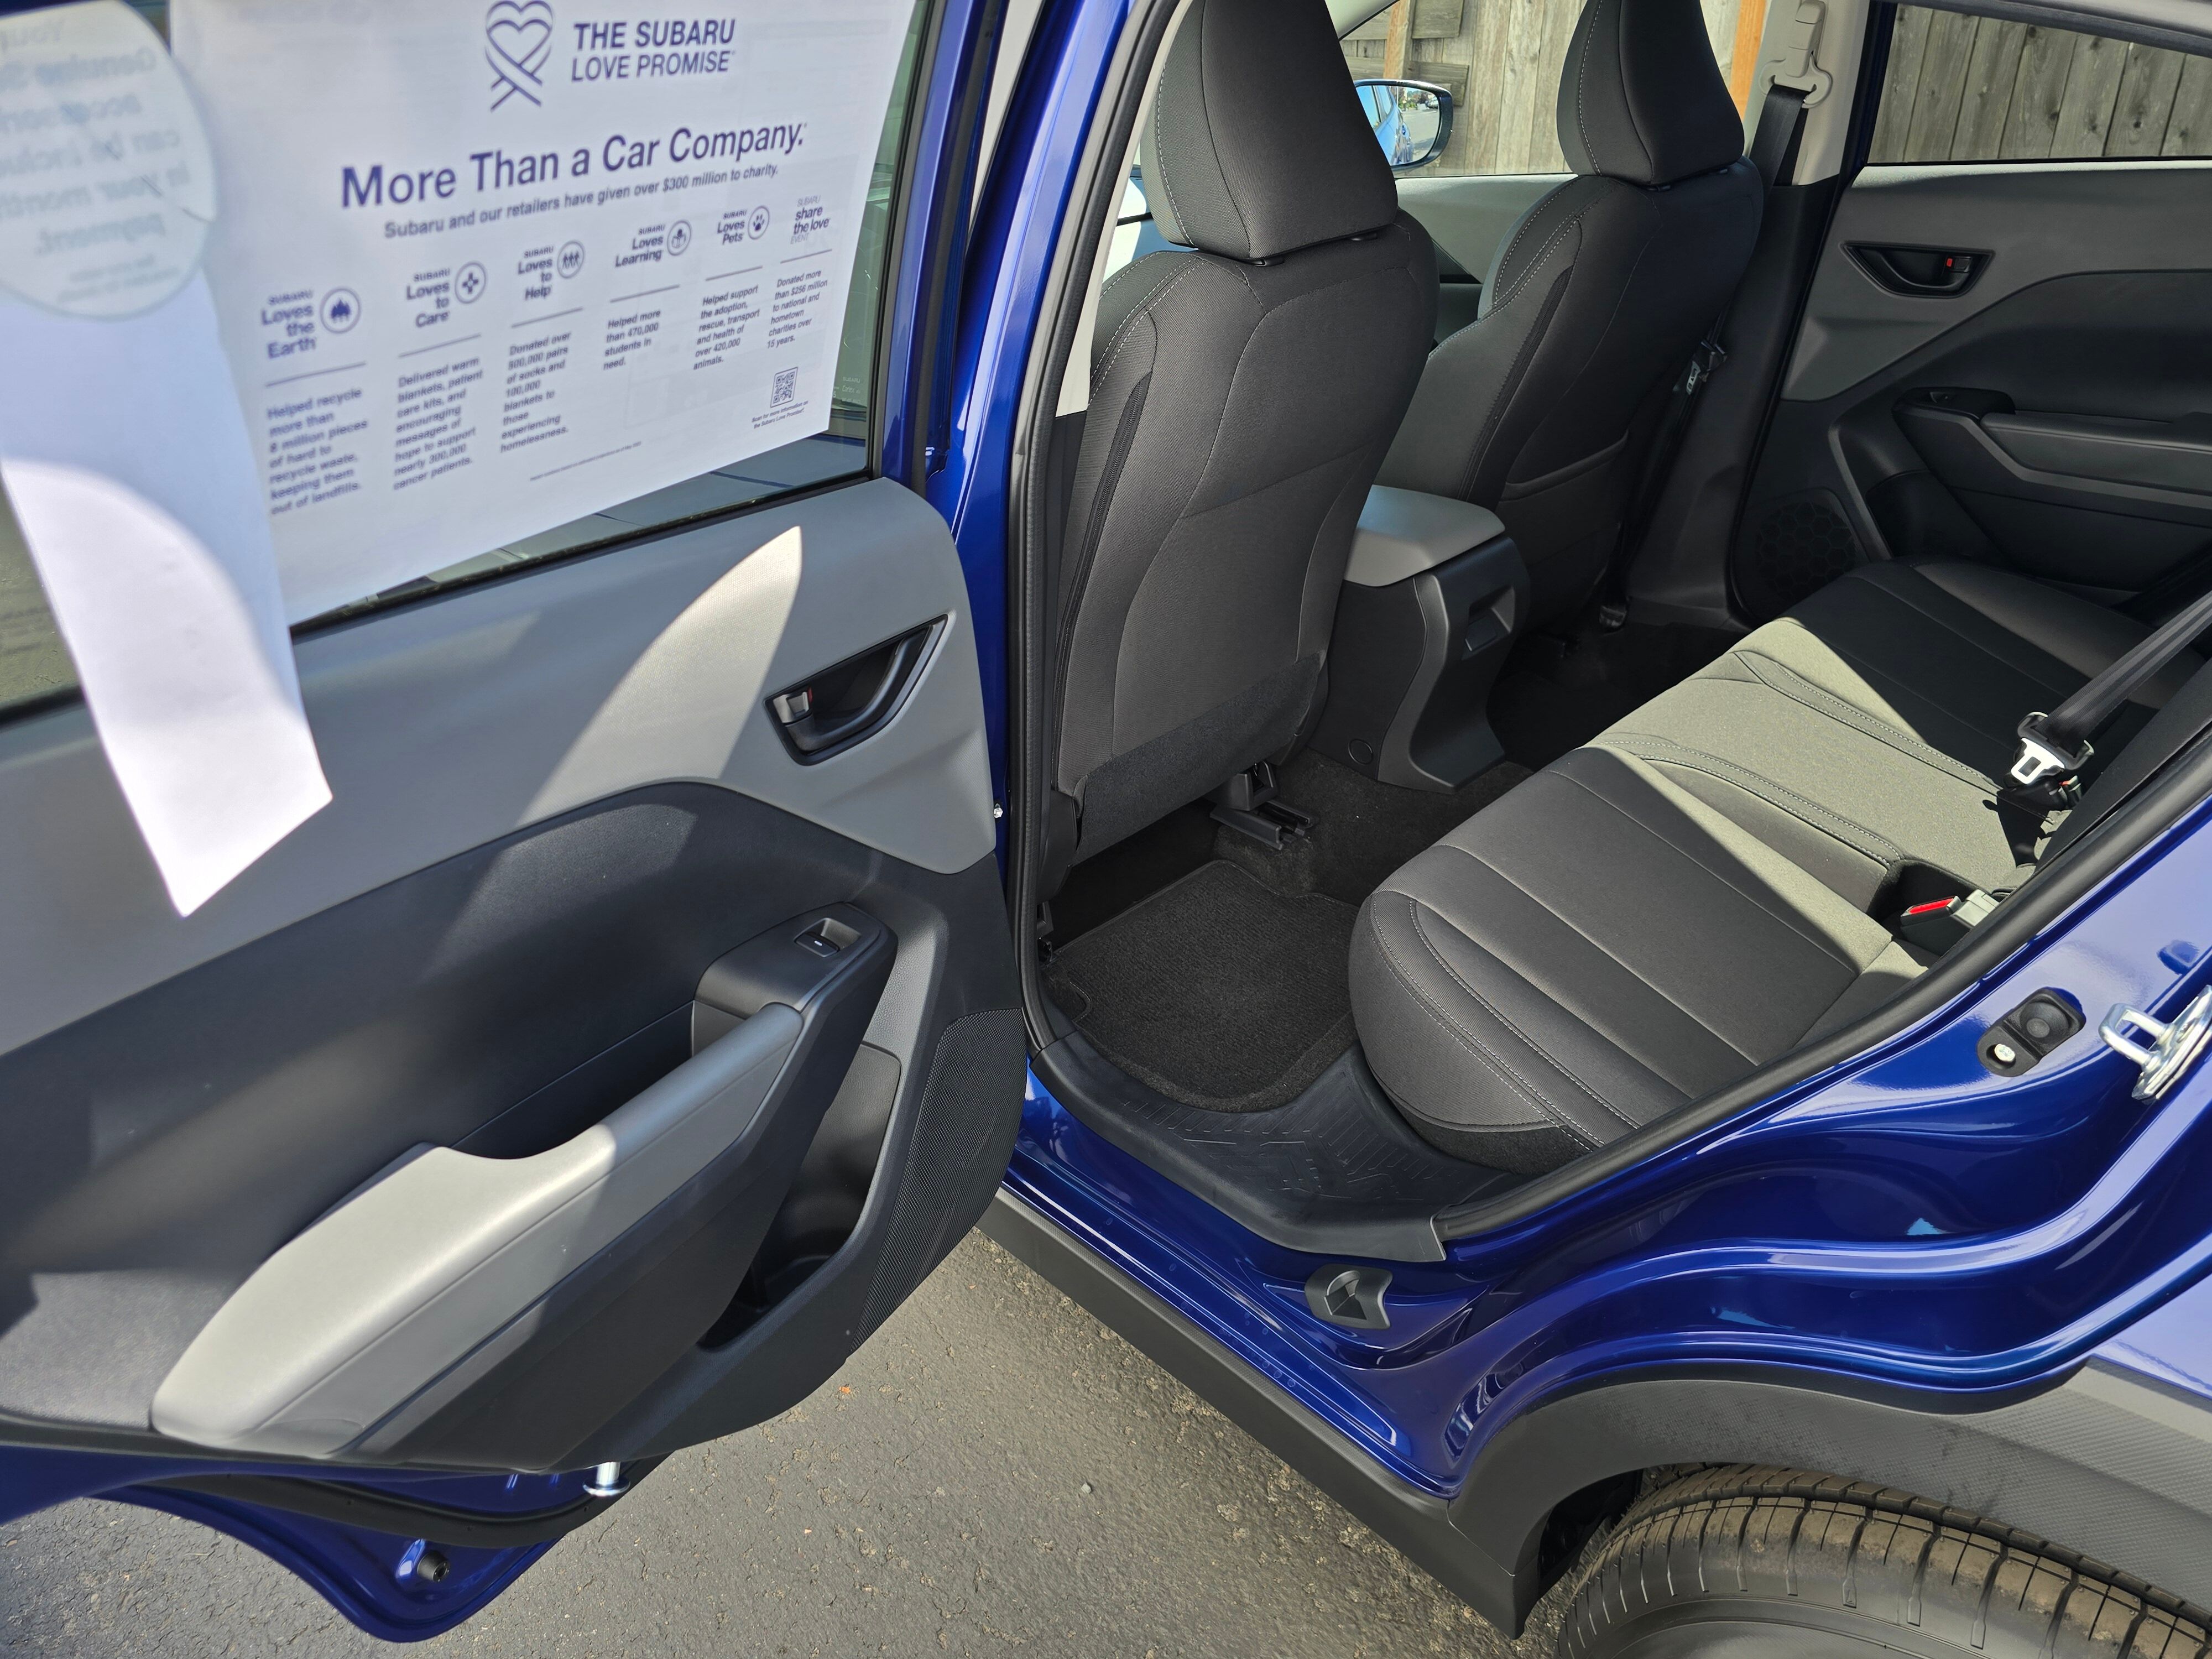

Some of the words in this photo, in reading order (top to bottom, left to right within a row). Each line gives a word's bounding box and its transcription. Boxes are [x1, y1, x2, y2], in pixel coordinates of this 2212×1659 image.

[573, 21, 628, 50] THE
[634, 18, 735, 48] SUBARU
[571, 55, 631, 82] LOVE
[636, 50, 732, 78] PROMISE
[341, 164, 457, 208] More
[469, 149, 560, 193] Than
[571, 147, 591, 177] a
[602, 134, 660, 171] Car
[669, 122, 804, 161] Company.
[384, 218, 444, 238] Subaru
[449, 211, 475, 229] and
[480, 208, 503, 223] our
[507, 196, 560, 218] retailers
[564, 188, 593, 208] have
[597, 185, 630, 205] given
[634, 182, 660, 195] over
[662, 175, 688, 192] $300
[692, 172, 727, 187] million
[731, 169, 740, 181] to
[743, 164, 779, 180] charity.
[797, 195, 821, 207] SUBARU
[723, 210, 747, 220] SUBARU
[795, 206, 823, 221] share
[638, 225, 665, 235] SUBARU
[717, 221, 745, 234] Loves
[794, 222, 809, 234] the
[810, 218, 829, 231] love
[632, 236, 664, 250] Loves
[722, 233, 743, 245] Pets
[790, 234, 809, 244] EVENT
[524, 246, 554, 258] SUBARU
[615, 249, 662, 268] Learning
[414, 268, 450, 282] SUBARU
[518, 259, 553, 275] Loves
[540, 272, 552, 283] to
[776, 273, 805, 288] Donated
[805, 270, 821, 280] more
[406, 282, 450, 300] Loves
[524, 285, 552, 300] Help
[702, 291, 729, 306] Helped
[730, 284, 759, 299] support
[775, 290, 789, 300] than
[791, 284, 805, 296] $256
[807, 279, 828, 291] million
[436, 297, 450, 309] to
[701, 311, 712, 320] the
[714, 302, 748, 316] adoption,
[773, 304, 779, 312] to
[781, 295, 807, 310] national
[808, 292, 820, 302] and
[261, 305, 314, 326] Loves
[415, 311, 449, 328] Care
[608, 314, 638, 330] Helped
[640, 310, 661, 322] more
[698, 320, 726, 332] rescue,
[727, 309, 760, 325] transport
[770, 310, 804, 325] hometown
[286, 322, 315, 337] the
[606, 332, 625, 343] than
[628, 322, 659, 337] 470,000
[697, 333, 711, 345] and
[713, 328, 735, 341] health
[737, 324, 745, 334] of
[769, 324, 796, 337] charities
[798, 318, 812, 328] over
[267, 338, 316, 359] Earth
[509, 337, 550, 356] Donated
[551, 332, 571, 344] over
[605, 341, 641, 356] students
[695, 347, 712, 358] over
[713, 338, 740, 352] 420,000
[767, 339, 775, 349] 15
[776, 335, 795, 348] years.
[546, 347, 568, 361] pairs
[693, 356, 724, 370] animals.
[398, 364, 448, 388] Delivered
[452, 357, 479, 372] warm
[507, 373, 517, 385] of
[519, 367, 546, 381] socks
[548, 359, 566, 372] and
[603, 357, 626, 371] need.
[398, 383, 445, 404] blankets,
[448, 369, 483, 389] patient
[267, 398, 313, 419] Helped
[317, 389, 362, 406] recycle
[397, 404, 420, 419] care
[424, 397, 444, 410] kits,
[447, 389, 466, 403] and
[504, 394, 543, 413] blankets
[546, 389, 555, 400] to
[270, 421, 302, 436] more
[306, 413, 334, 427] than
[397, 406, 461, 433] encouraging
[502, 415, 561, 440] experiencing
[503, 411, 529, 426] those
[328, 420, 368, 439] pieces
[395, 424, 448, 447] messages
[451, 417, 462, 430] of
[395, 447, 421, 462] hope
[424, 442, 434, 452] to
[437, 426, 476, 447] support
[500, 426, 568, 453] homelessness.
[269, 456, 283, 468] of
[287, 447, 316, 463] hard
[320, 446, 331, 455] to
[269, 465, 316, 483] recycle
[394, 459, 425, 476] nearly
[394, 472, 428, 491] cancer
[431, 456, 472, 479] patients.
[270, 479, 320, 499] keeping
[324, 469, 354, 483] them
[271, 500, 293, 515] out
[296, 495, 309, 508] of
